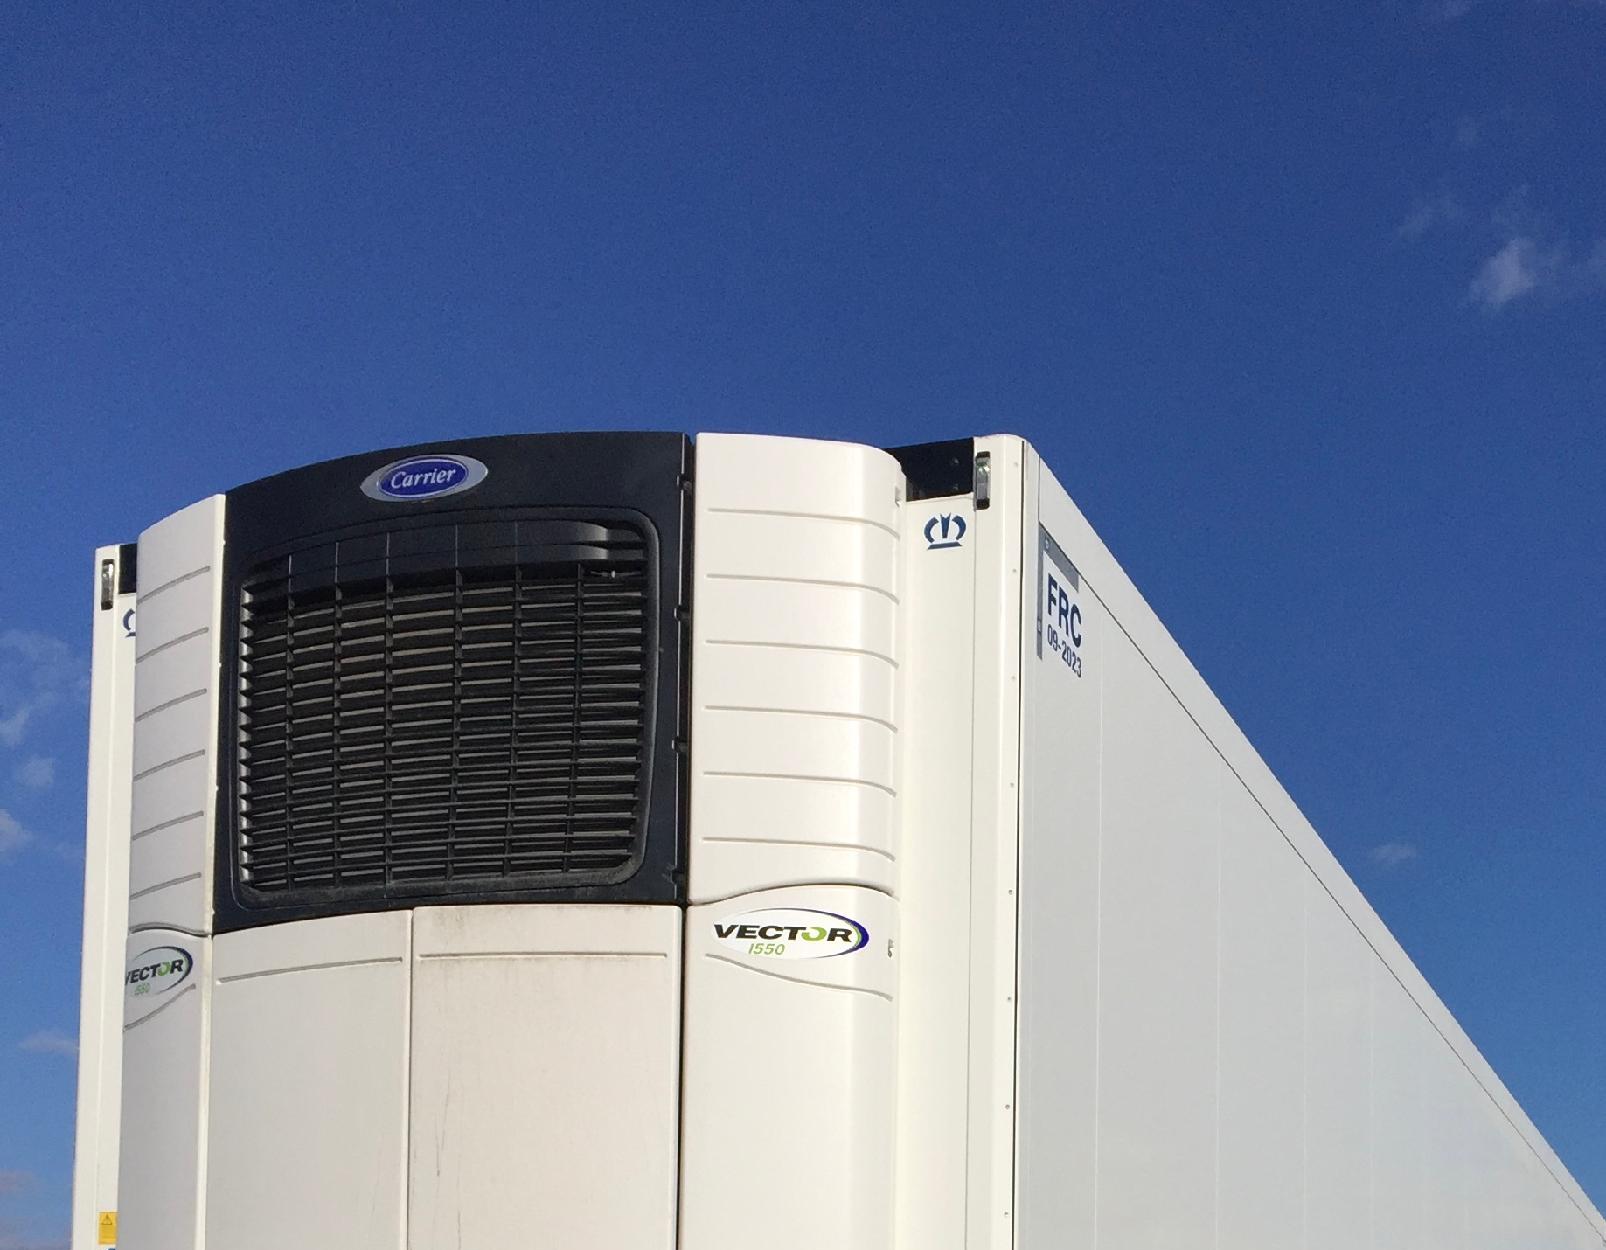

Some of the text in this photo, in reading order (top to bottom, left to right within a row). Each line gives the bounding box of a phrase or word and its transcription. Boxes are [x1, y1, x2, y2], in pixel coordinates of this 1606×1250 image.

[390, 467, 456, 489] Carrier
[1047, 572, 1082, 649] FRC
[1046, 623, 1082, 679] 09-2023
[713, 923, 853, 943] VECTOR
[748, 942, 786, 956] 1550
